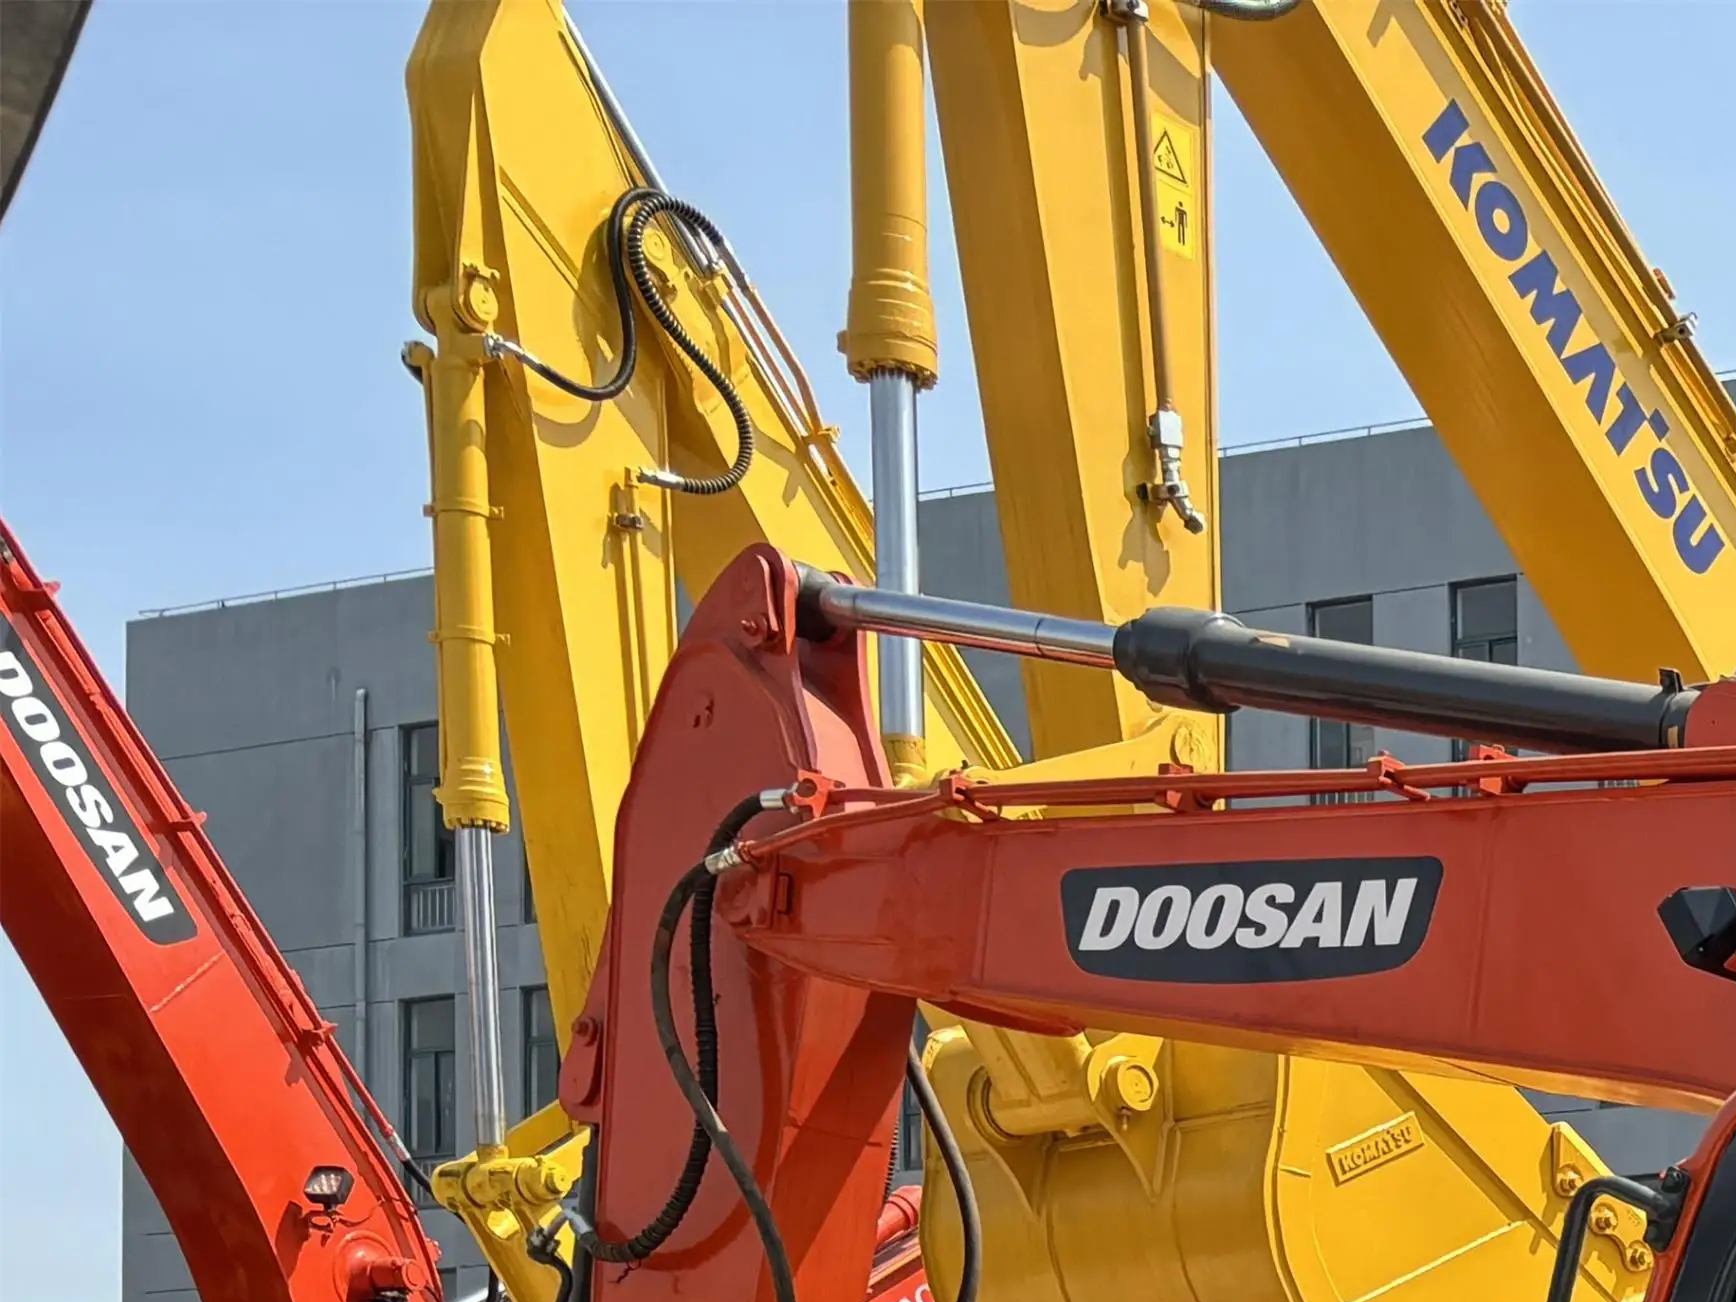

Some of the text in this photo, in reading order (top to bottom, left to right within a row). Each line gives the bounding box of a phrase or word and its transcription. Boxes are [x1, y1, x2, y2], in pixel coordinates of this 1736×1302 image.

[1422, 98, 1725, 575] KOMATSU
[0, 651, 174, 922] DOOSAN
[1078, 878, 1418, 951] DOOSAN
[1338, 1126, 1413, 1176] KOMATSU
